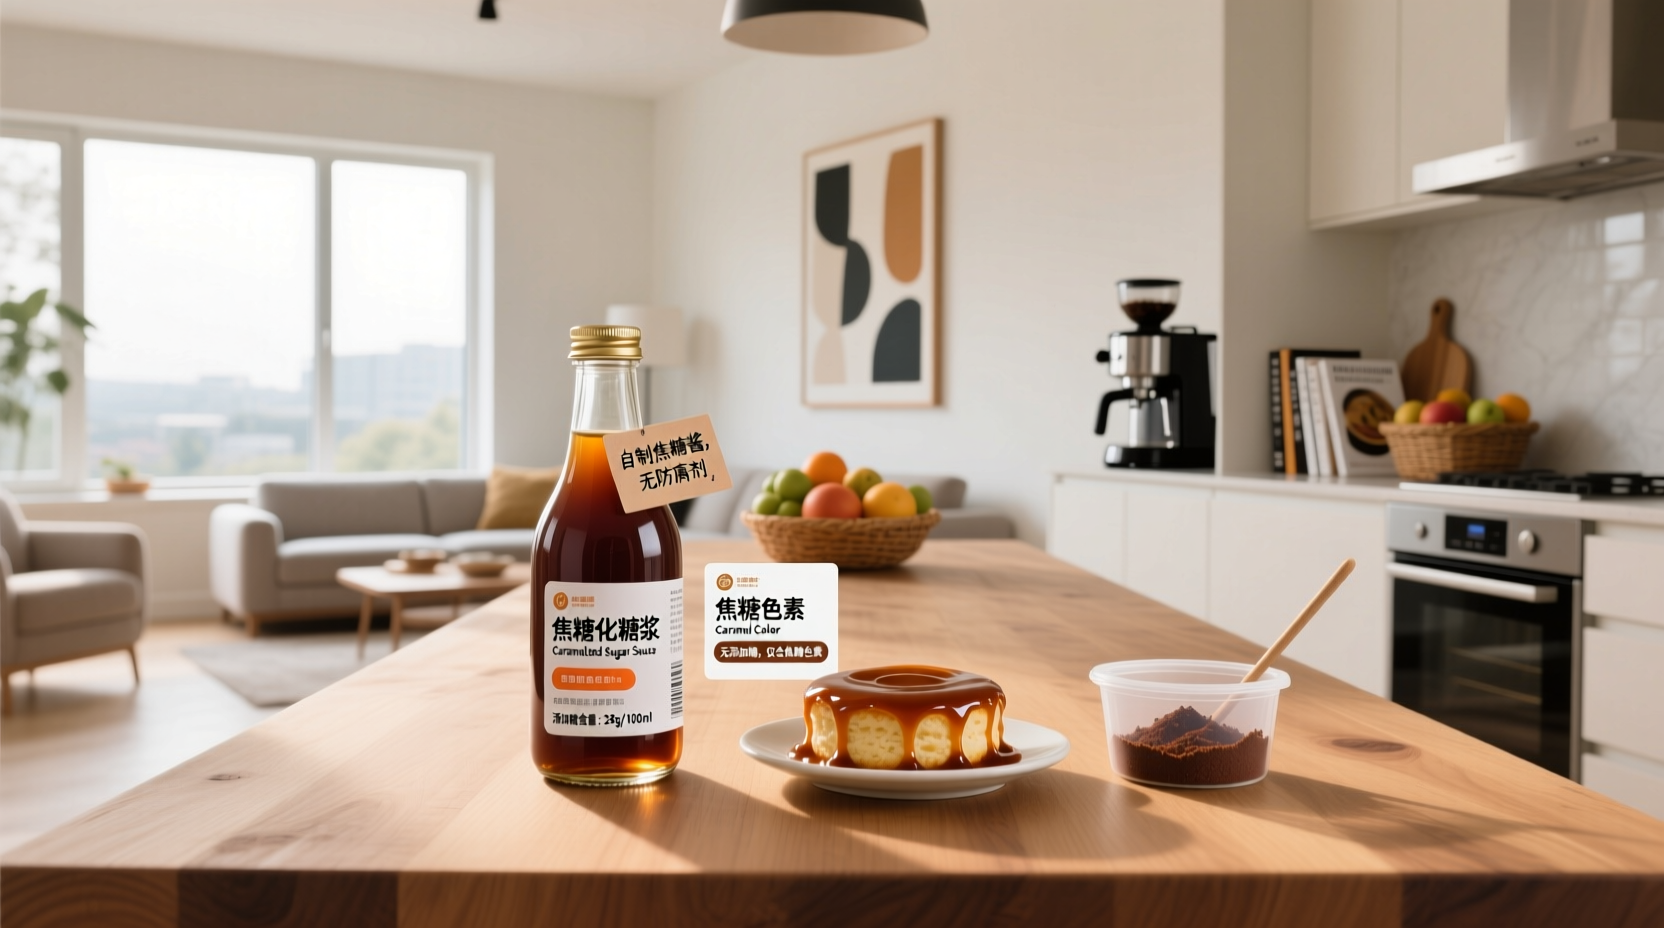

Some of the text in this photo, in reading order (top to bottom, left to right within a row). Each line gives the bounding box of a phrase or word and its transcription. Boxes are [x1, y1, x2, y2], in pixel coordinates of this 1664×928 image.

[715, 596, 805, 621] 焦糖色素
[552, 615, 660, 642] 焦糖化糖浆
[754, 623, 781, 634] Color
